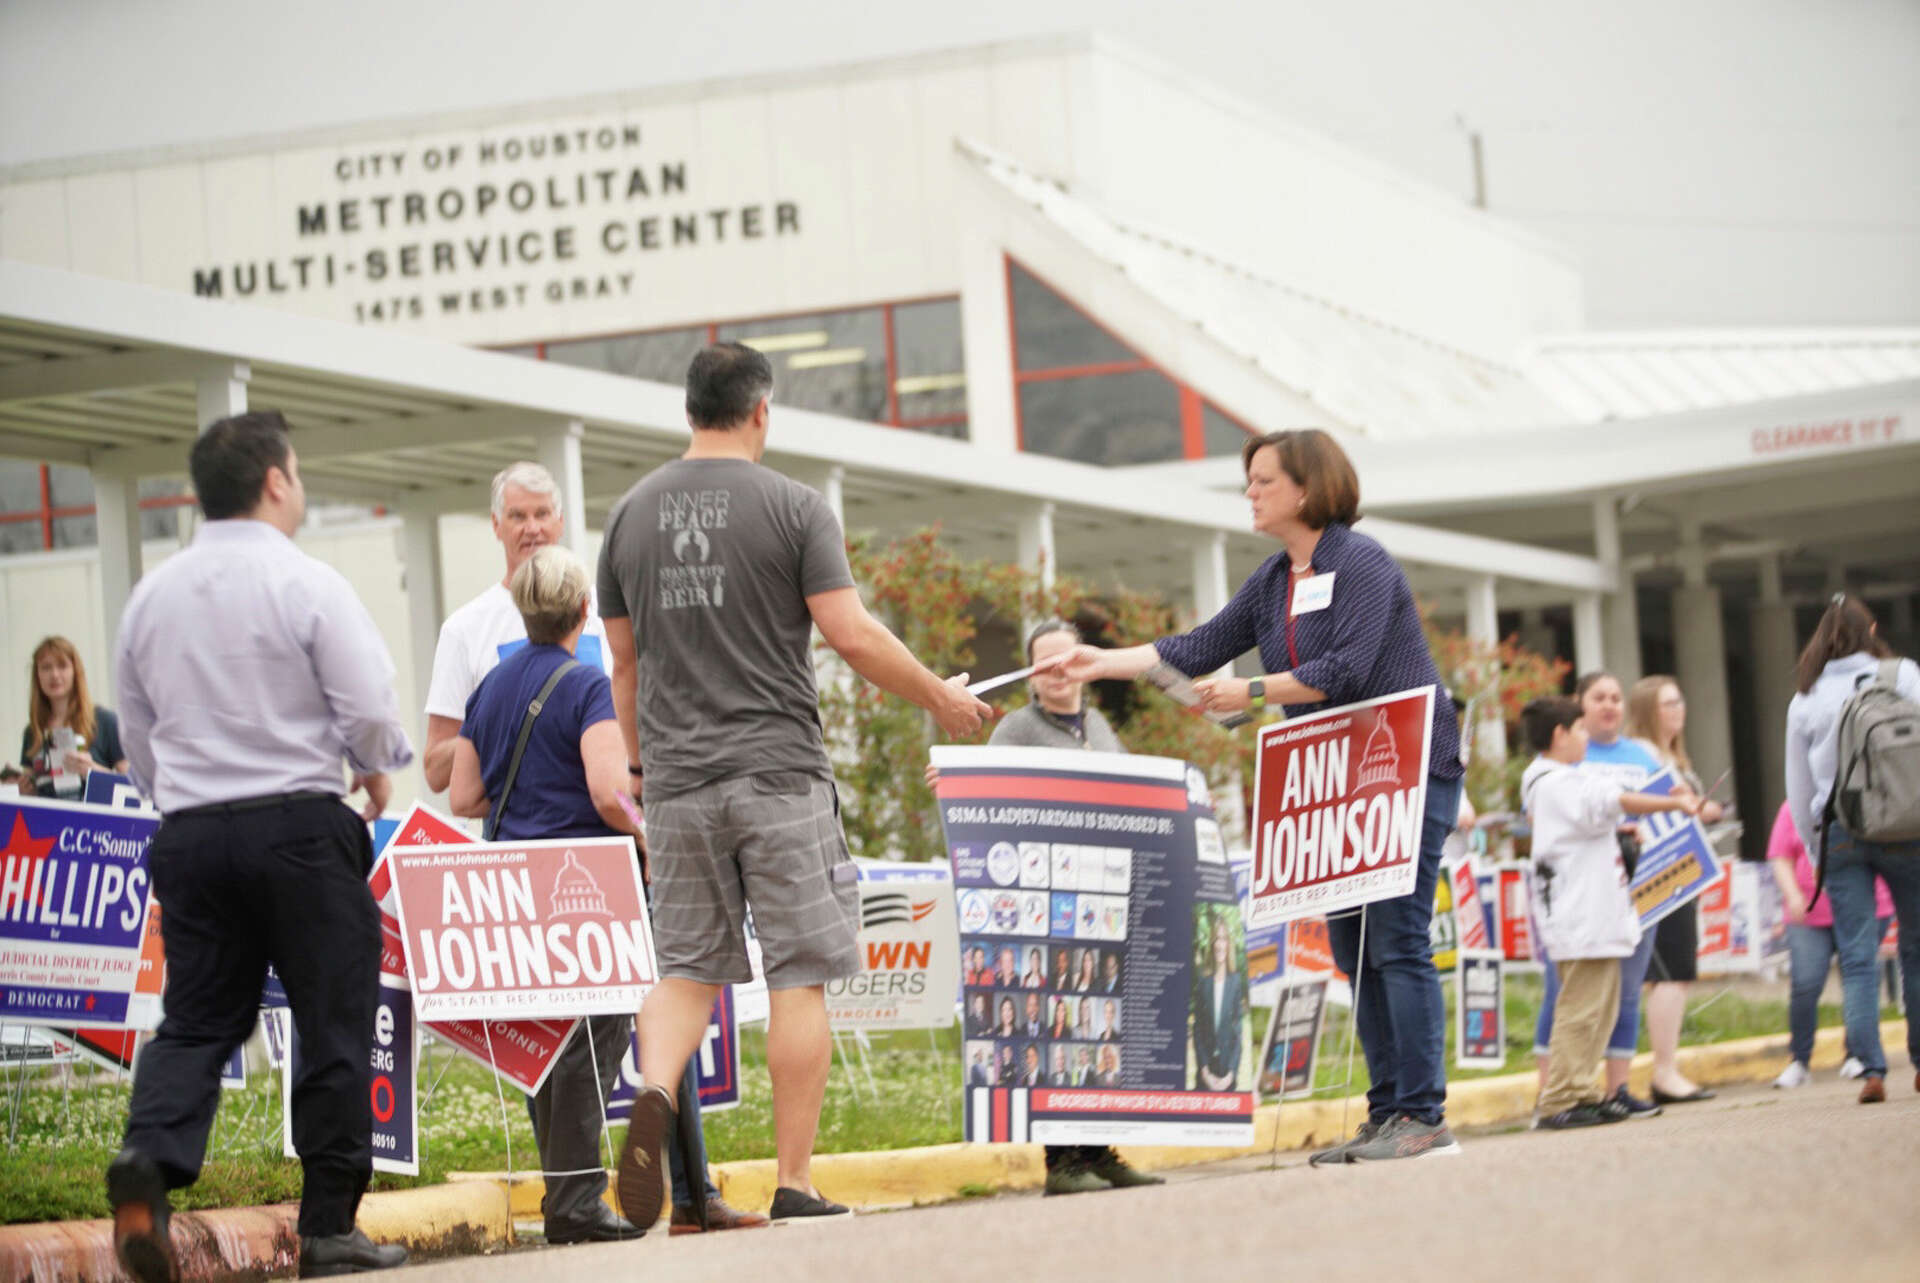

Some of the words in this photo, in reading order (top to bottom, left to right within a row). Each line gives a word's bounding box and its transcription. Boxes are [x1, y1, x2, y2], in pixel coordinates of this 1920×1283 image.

[335, 152, 405, 181] CITY
[423, 146, 461, 171] OF
[480, 126, 641, 164] HOUSTON
[298, 161, 686, 236] METROPOLITAN
[194, 226, 576, 298] MULTI-SERVICE
[602, 202, 800, 252] CENTER
[356, 297, 422, 324] 1475
[440, 284, 527, 313] WEST
[546, 273, 633, 302] GRAY
[658, 508, 728, 531] PEACE
[660, 490, 729, 511] INNER
[1280, 735, 1350, 812] ANN
[947, 806, 988, 824] SIMA
[1096, 813, 1157, 833] ENDORSED
[59, 827, 91, 854] C.C.
[402, 852, 526, 868] www.AnnJohnson.com
[1254, 786, 1419, 894] JOHNSON
[0, 854, 147, 931] HILLIPS
[442, 867, 537, 925] ANN
[1269, 893, 1304, 912] STATE
[1335, 872, 1387, 895] DISTRICT
[52, 955, 99, 971] DISTRICT
[102, 959, 134, 974] JUDGE
[417, 919, 652, 991] JOHNSON
[8, 990, 80, 1009] DEMOCRAT
[449, 993, 495, 1008] STATE
[549, 990, 623, 1005] DISTRICT
[631, 989, 648, 1001] 13
[827, 971, 926, 996] OGERS
